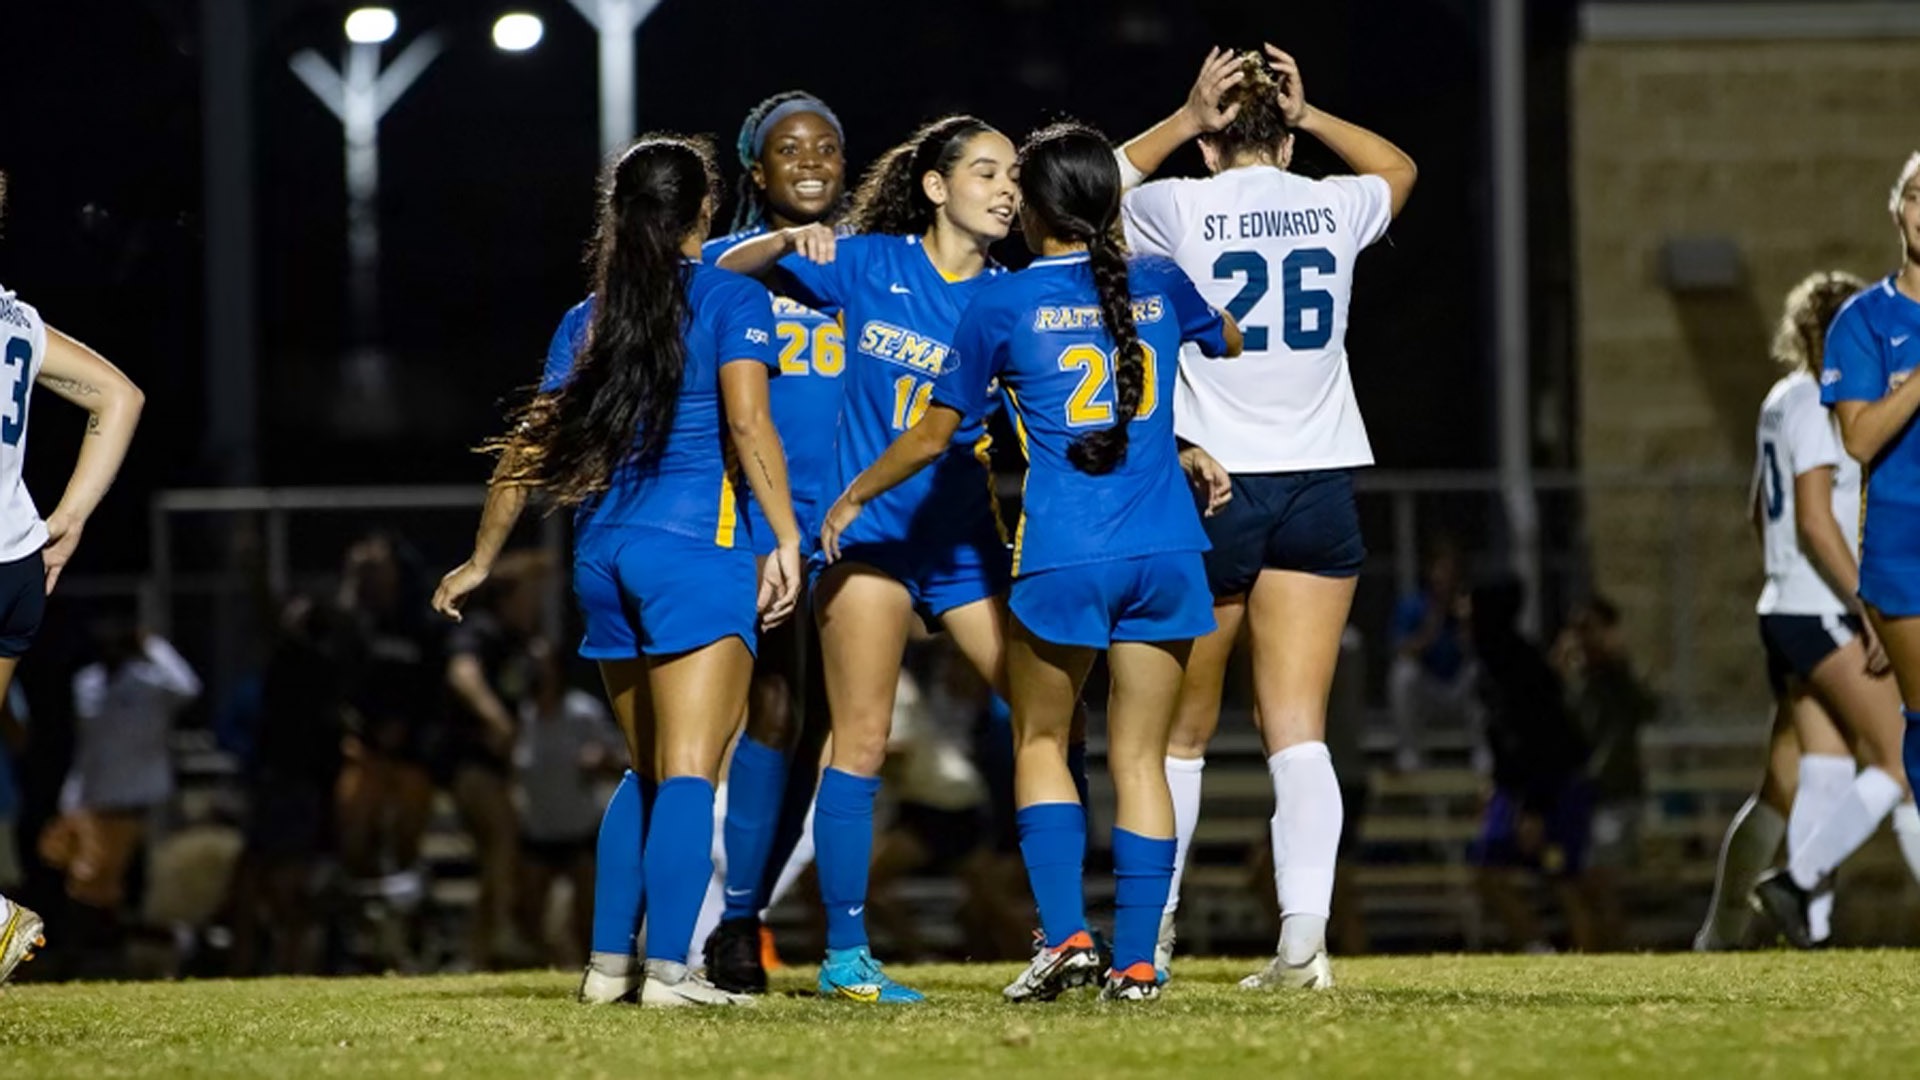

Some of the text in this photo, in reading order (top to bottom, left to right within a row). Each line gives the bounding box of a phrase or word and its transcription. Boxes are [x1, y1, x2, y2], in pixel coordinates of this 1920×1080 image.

[1204, 207, 1337, 241] ST. EDWARD'S
[1036, 297, 1163, 330] RATTRS
[1212, 247, 1337, 351] 26
[776, 321, 846, 377] 26
